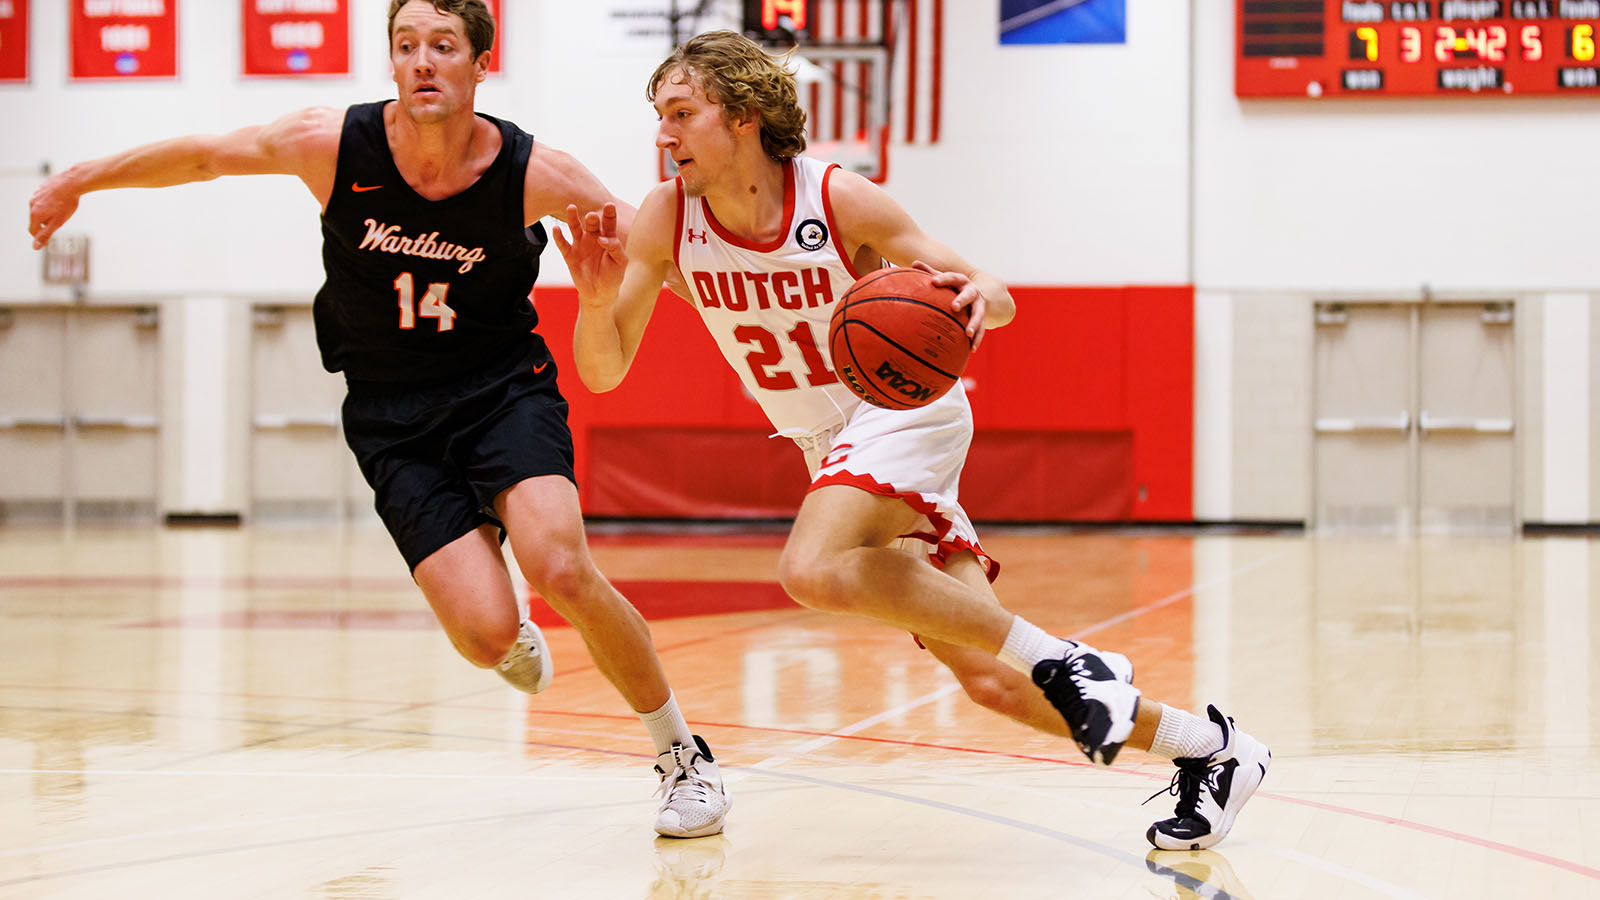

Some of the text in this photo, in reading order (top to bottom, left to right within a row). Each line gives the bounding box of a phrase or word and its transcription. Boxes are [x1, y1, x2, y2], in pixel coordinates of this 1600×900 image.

[1356, 27, 1378, 62] 7
[1400, 26, 1421, 63] 3
[1520, 25, 1543, 62] 5
[1572, 24, 1595, 61] 6
[358, 218, 486, 274] Wartburg
[394, 272, 457, 332] 14
[692, 267, 834, 312] DUTCH
[732, 320, 840, 391] 21
[875, 360, 938, 401] NCAA
